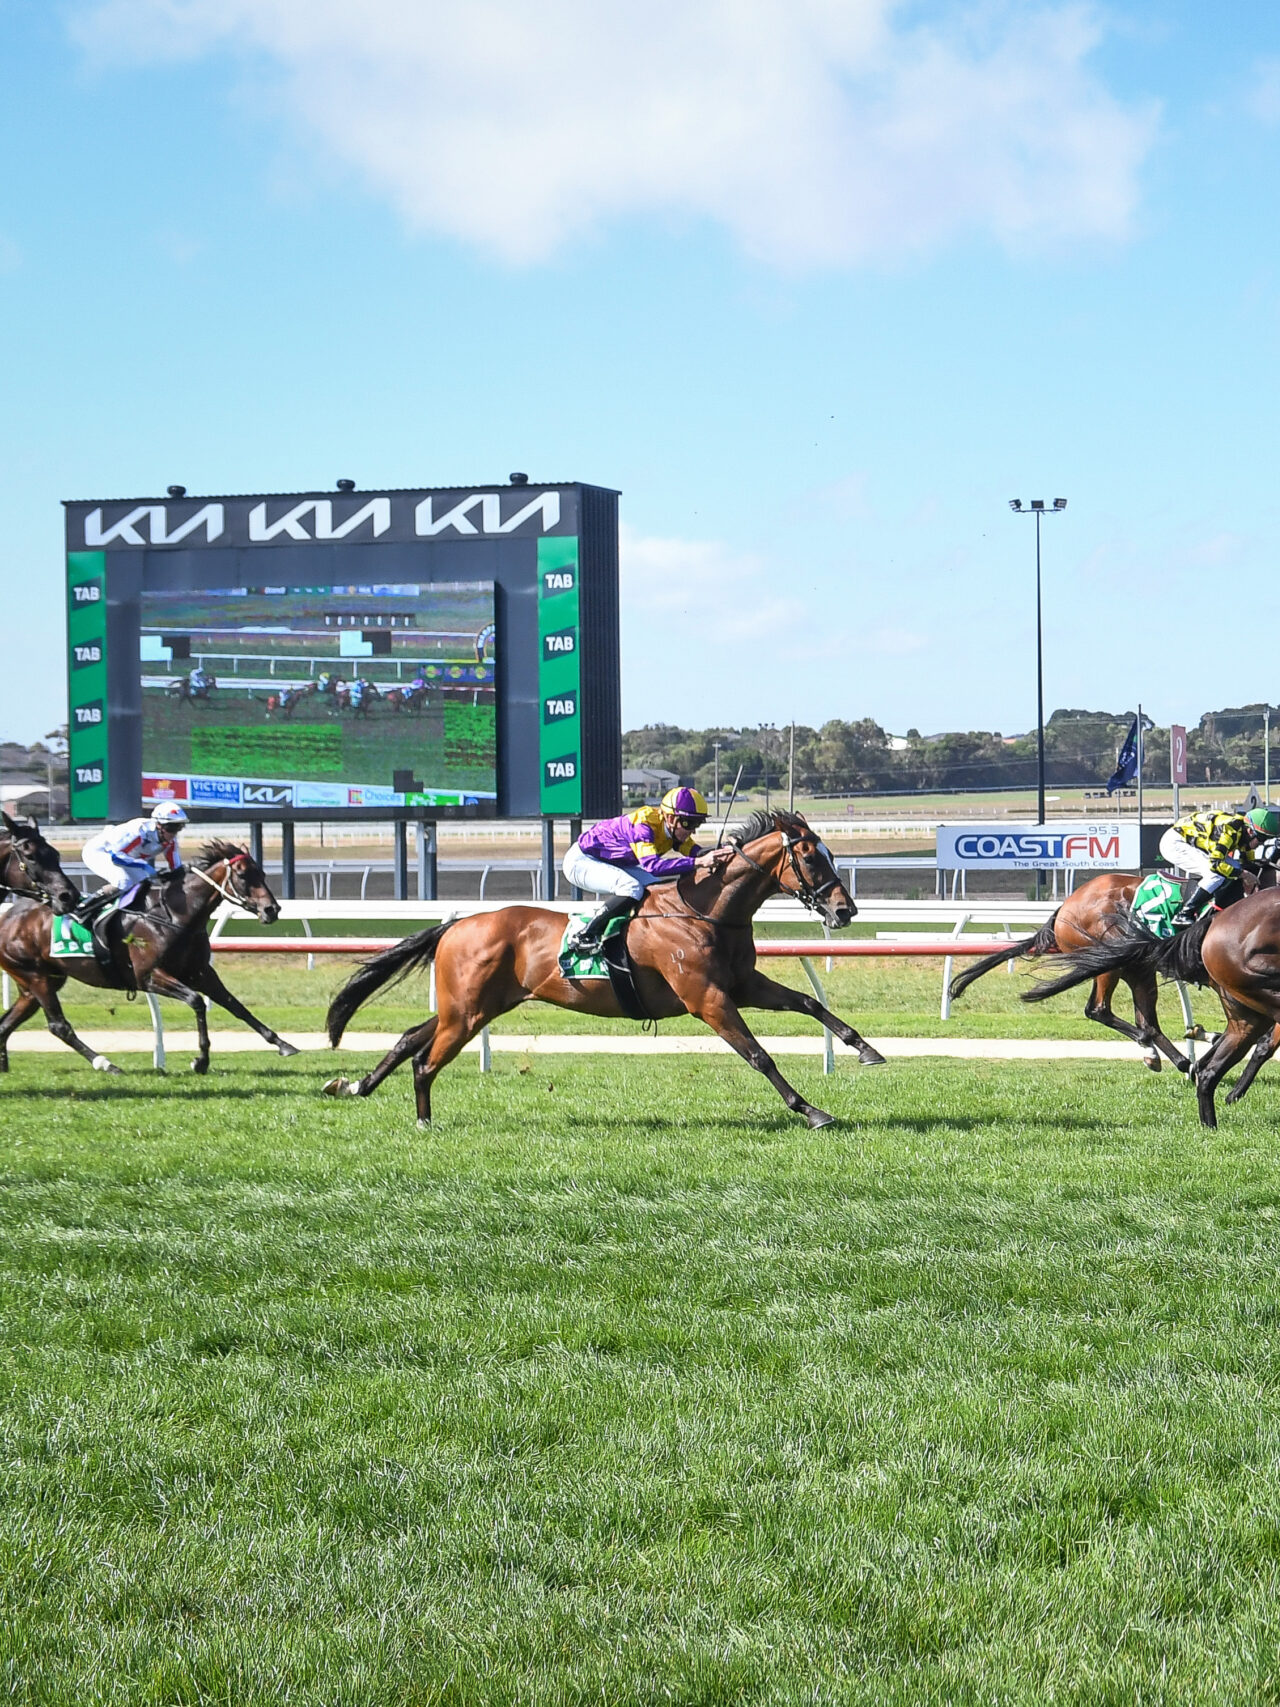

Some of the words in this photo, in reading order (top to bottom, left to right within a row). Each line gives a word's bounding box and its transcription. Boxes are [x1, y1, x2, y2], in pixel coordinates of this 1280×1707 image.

[545, 574, 573, 588] TAB
[73, 587, 99, 601] TAB
[546, 636, 574, 650] TAB
[74, 647, 100, 661] TAB
[547, 700, 574, 715] TAB
[75, 709, 101, 722] TAB
[1176, 736, 1183, 772] 2
[76, 769, 102, 783] TAB
[547, 763, 575, 777] TAB
[193, 781, 238, 793] VICTORY
[1088, 826, 1119, 835] 95.3
[1140, 880, 1173, 921] 2
